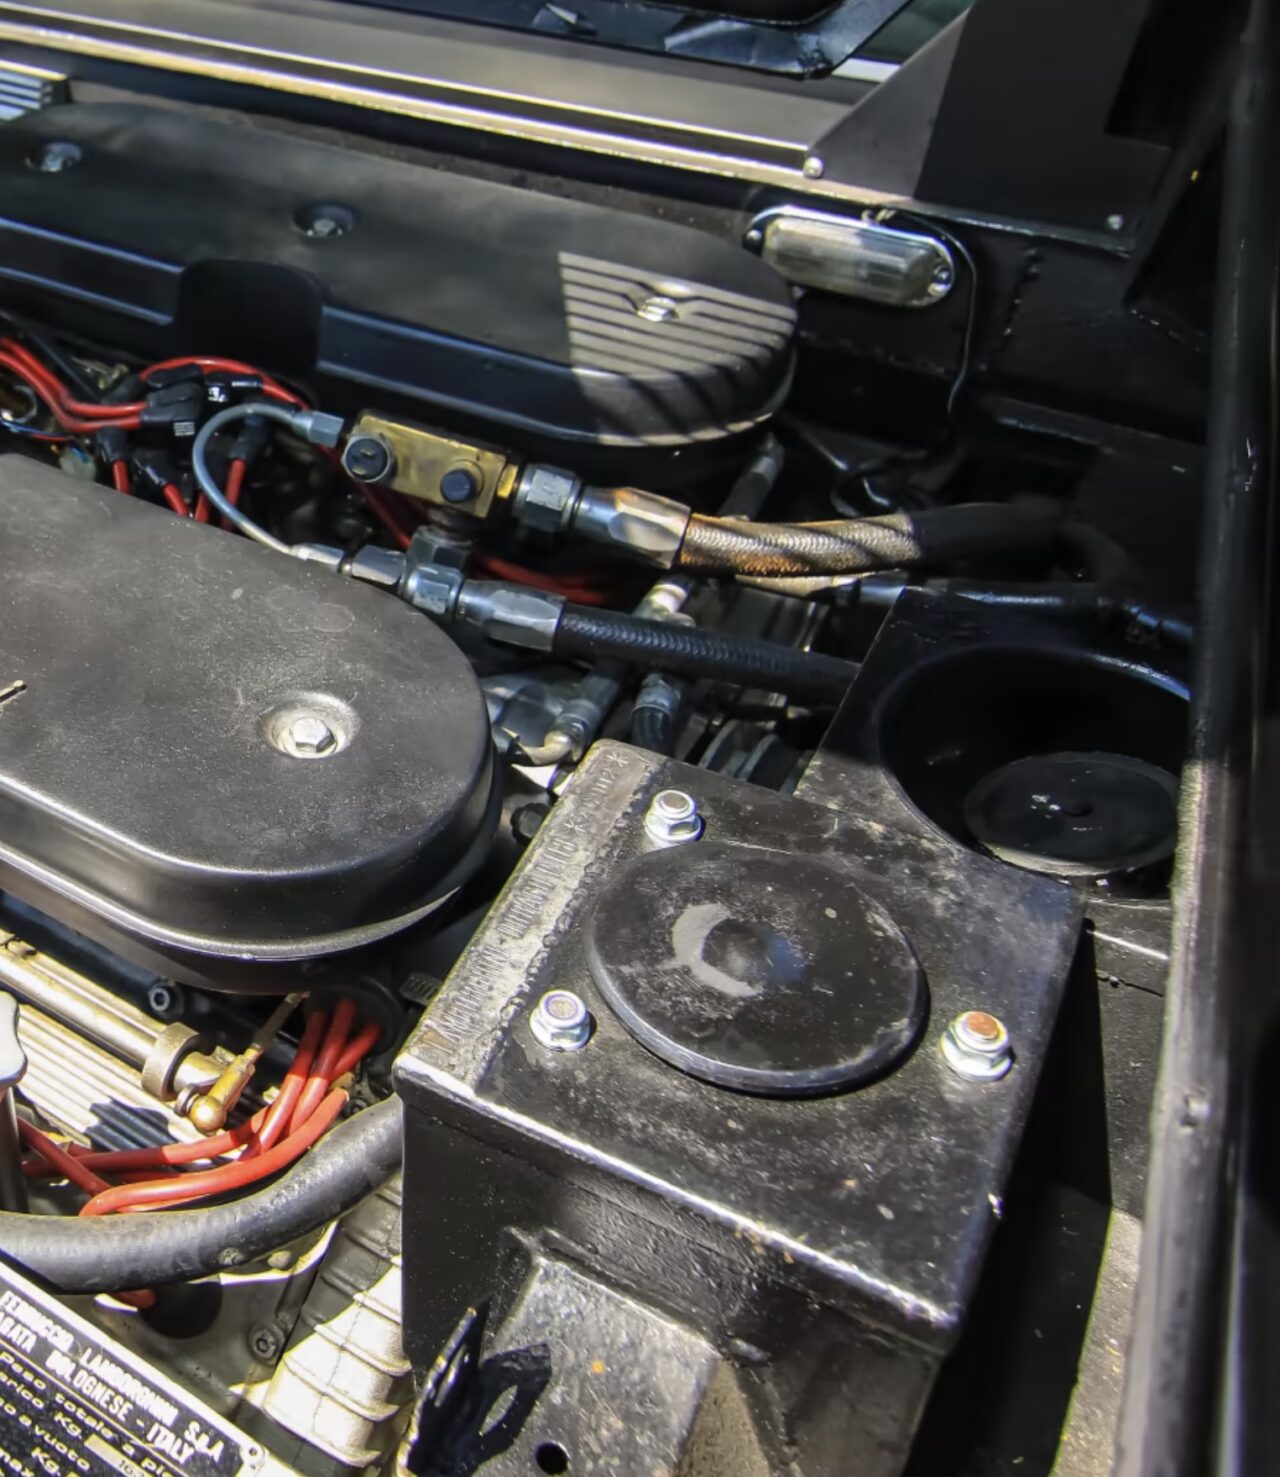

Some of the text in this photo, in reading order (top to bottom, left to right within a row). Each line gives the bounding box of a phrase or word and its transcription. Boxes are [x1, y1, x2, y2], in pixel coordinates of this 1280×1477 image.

[45, 1348, 134, 1422] BOLOGNESE
[146, 1421, 196, 1465] ITALY
[53, 1410, 83, 1440] Kg.
[54, 1391, 115, 1440] totale
[121, 1442, 136, 1456] a
[18, 1412, 33, 1428] a
[34, 1424, 91, 1471] vuoto
